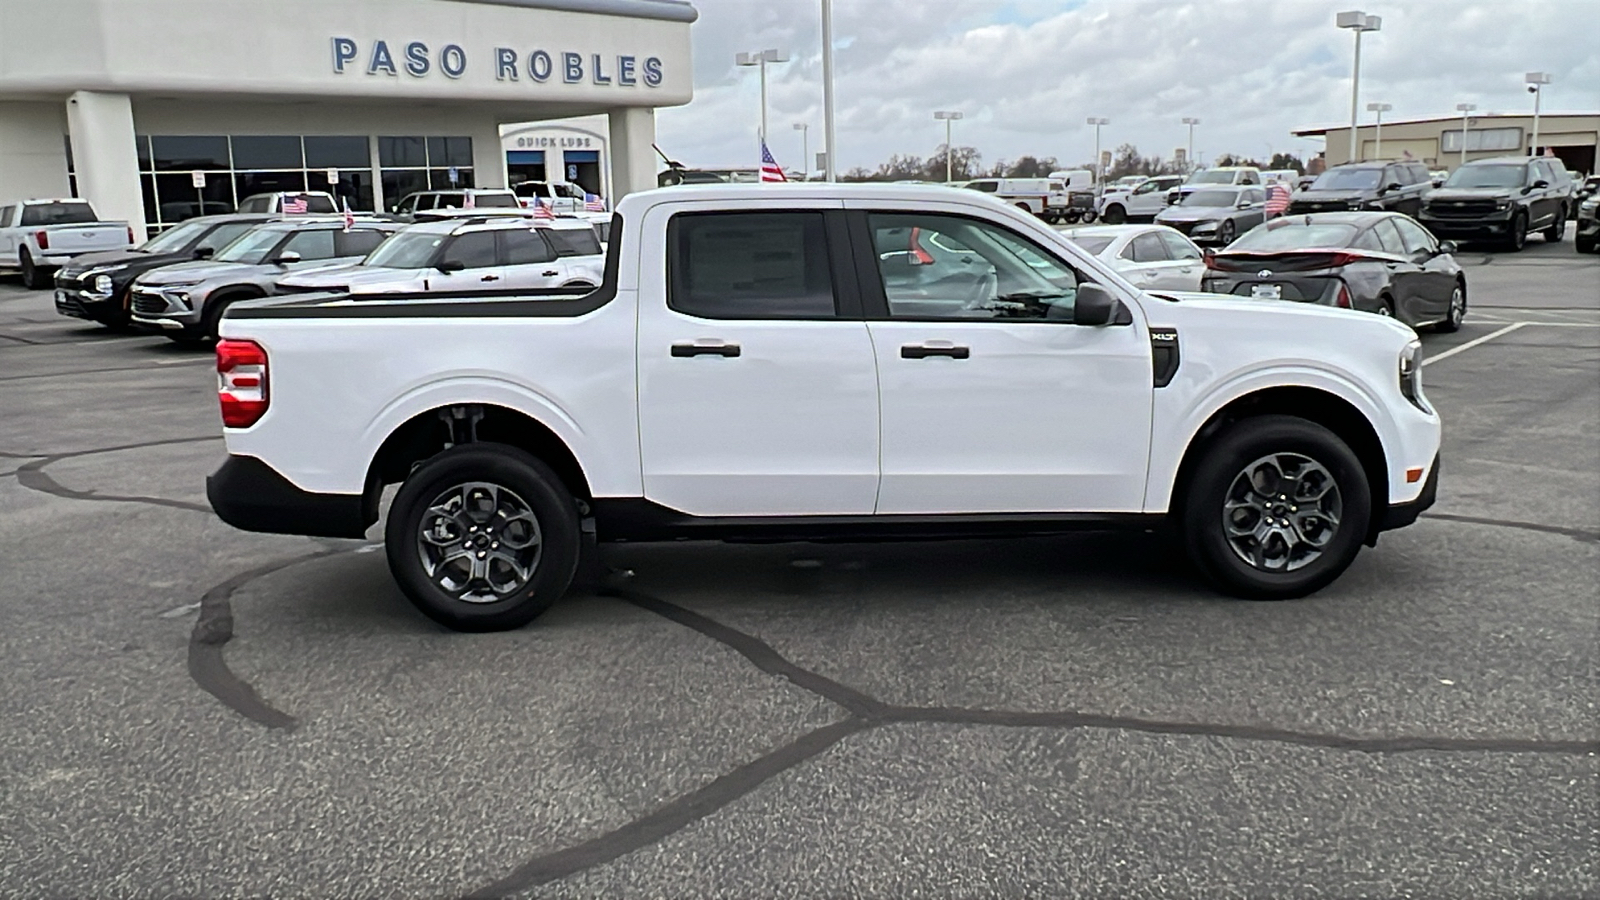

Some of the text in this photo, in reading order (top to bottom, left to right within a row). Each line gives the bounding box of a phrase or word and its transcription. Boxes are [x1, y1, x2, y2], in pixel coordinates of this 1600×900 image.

[331, 37, 663, 87] PASO ROBLES
[517, 137, 591, 147] QUICK LUBE
[1151, 333, 1178, 341] XLT
